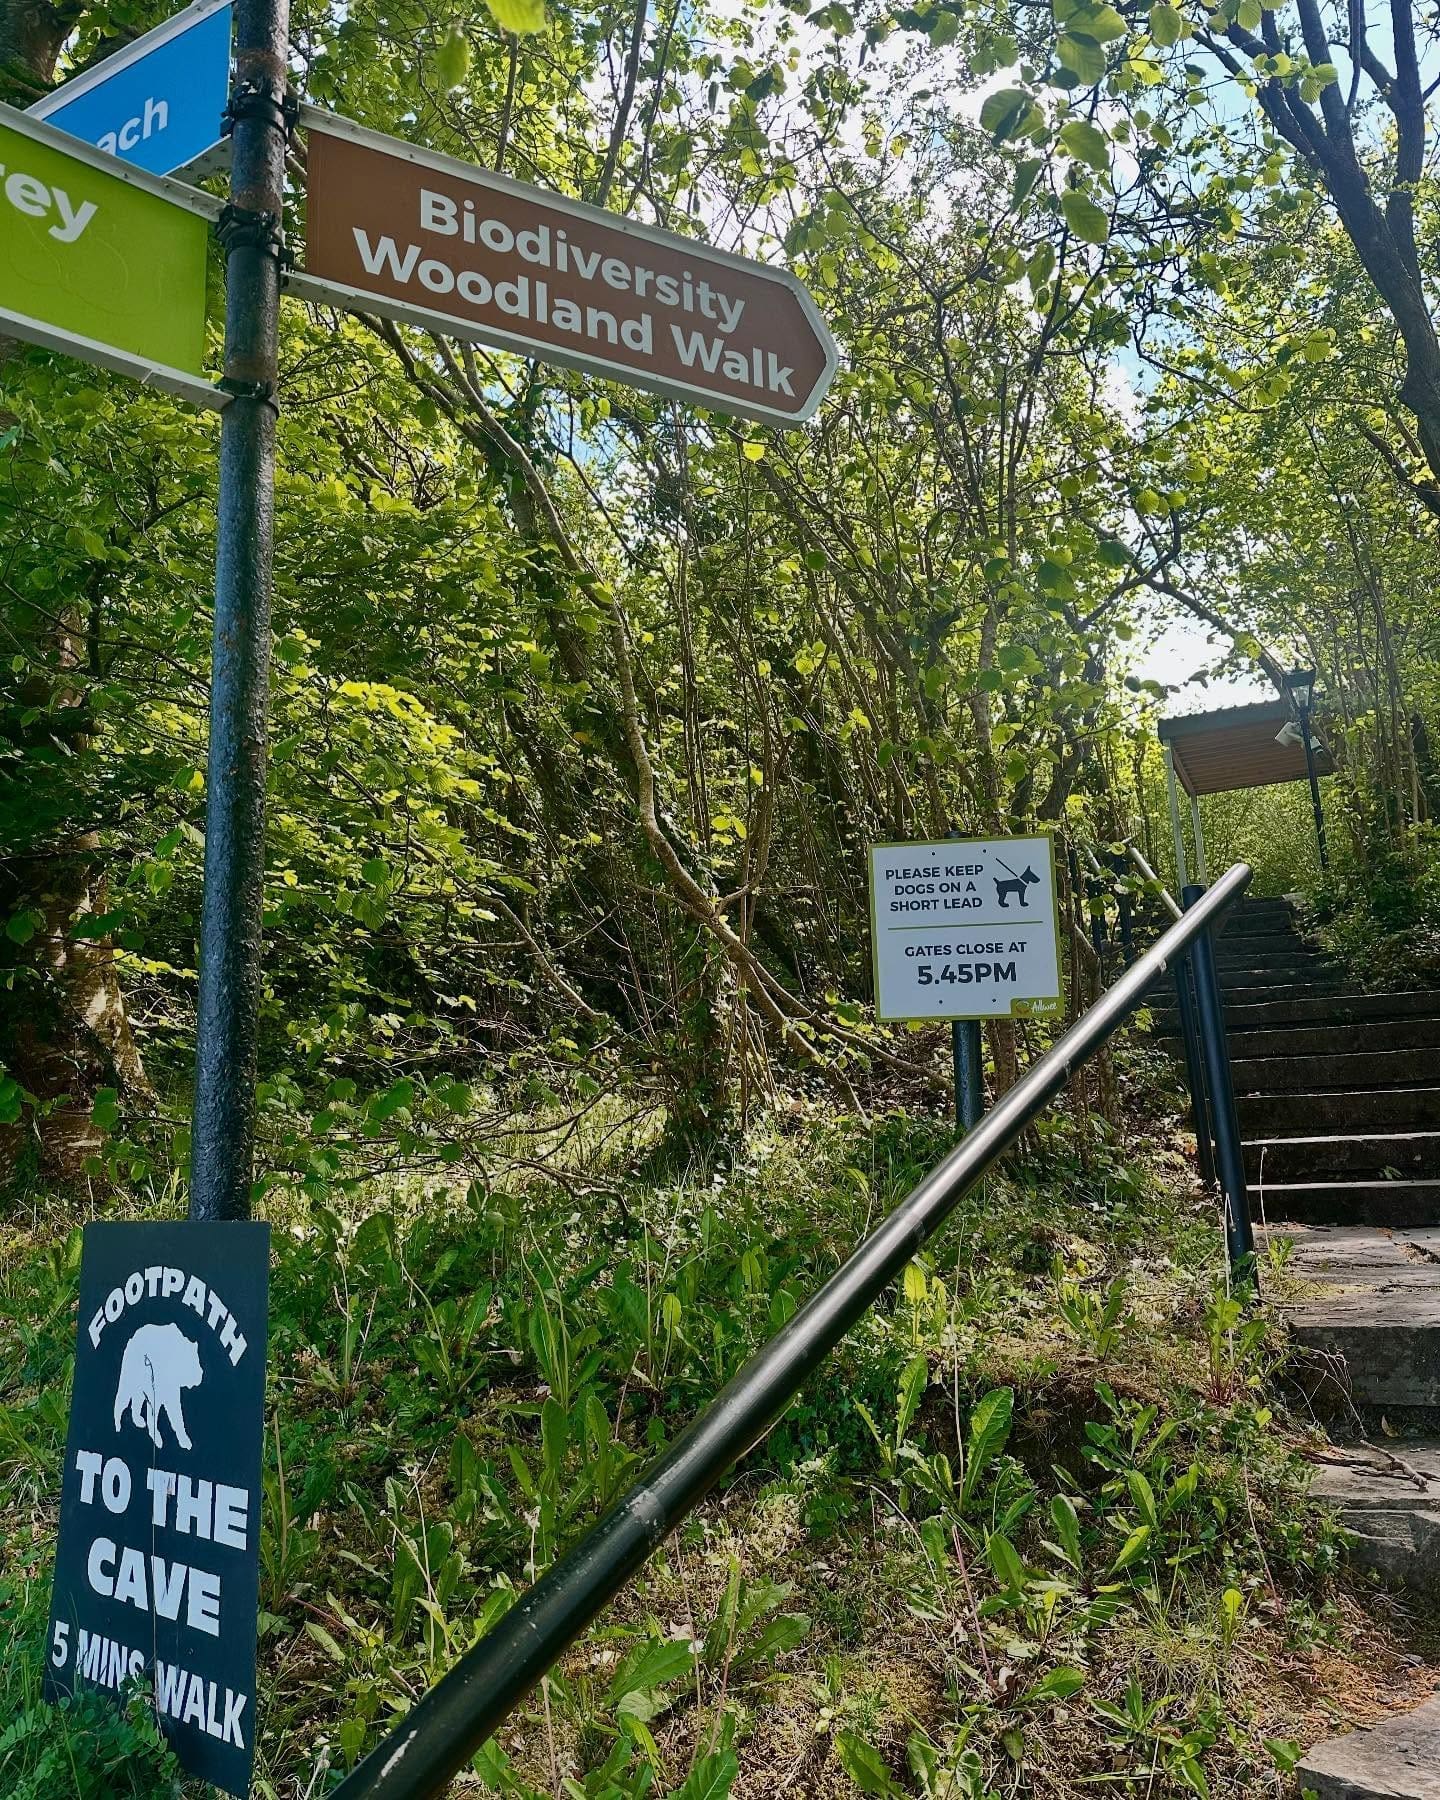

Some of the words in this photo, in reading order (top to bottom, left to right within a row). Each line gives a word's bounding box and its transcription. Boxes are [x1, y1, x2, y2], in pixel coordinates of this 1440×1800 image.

[0, 163, 98, 243] ey
[419, 188, 746, 332] Biodiversity
[352, 227, 653, 354] Woodland
[670, 323, 796, 397] Walk
[885, 867, 940, 880] PLEASE
[945, 864, 984, 876] KEEP
[890, 899, 940, 912] SHORT
[944, 897, 983, 909] LEAD
[894, 884, 935, 896] DOGS
[938, 882, 961, 893] ON
[965, 881, 977, 892] A
[904, 944, 952, 957] GATES
[956, 942, 1004, 954] CLOSE
[1008, 941, 1027, 953] AT
[917, 961, 1017, 985] 5.45PM
[88, 1265, 248, 1367] FOOTPATH
[75, 1449, 132, 1514] TO
[146, 1467, 249, 1551] THE
[86, 1537, 221, 1637] CAVE
[52, 1620, 70, 1668] 5
[155, 1659, 247, 1749] WALK
